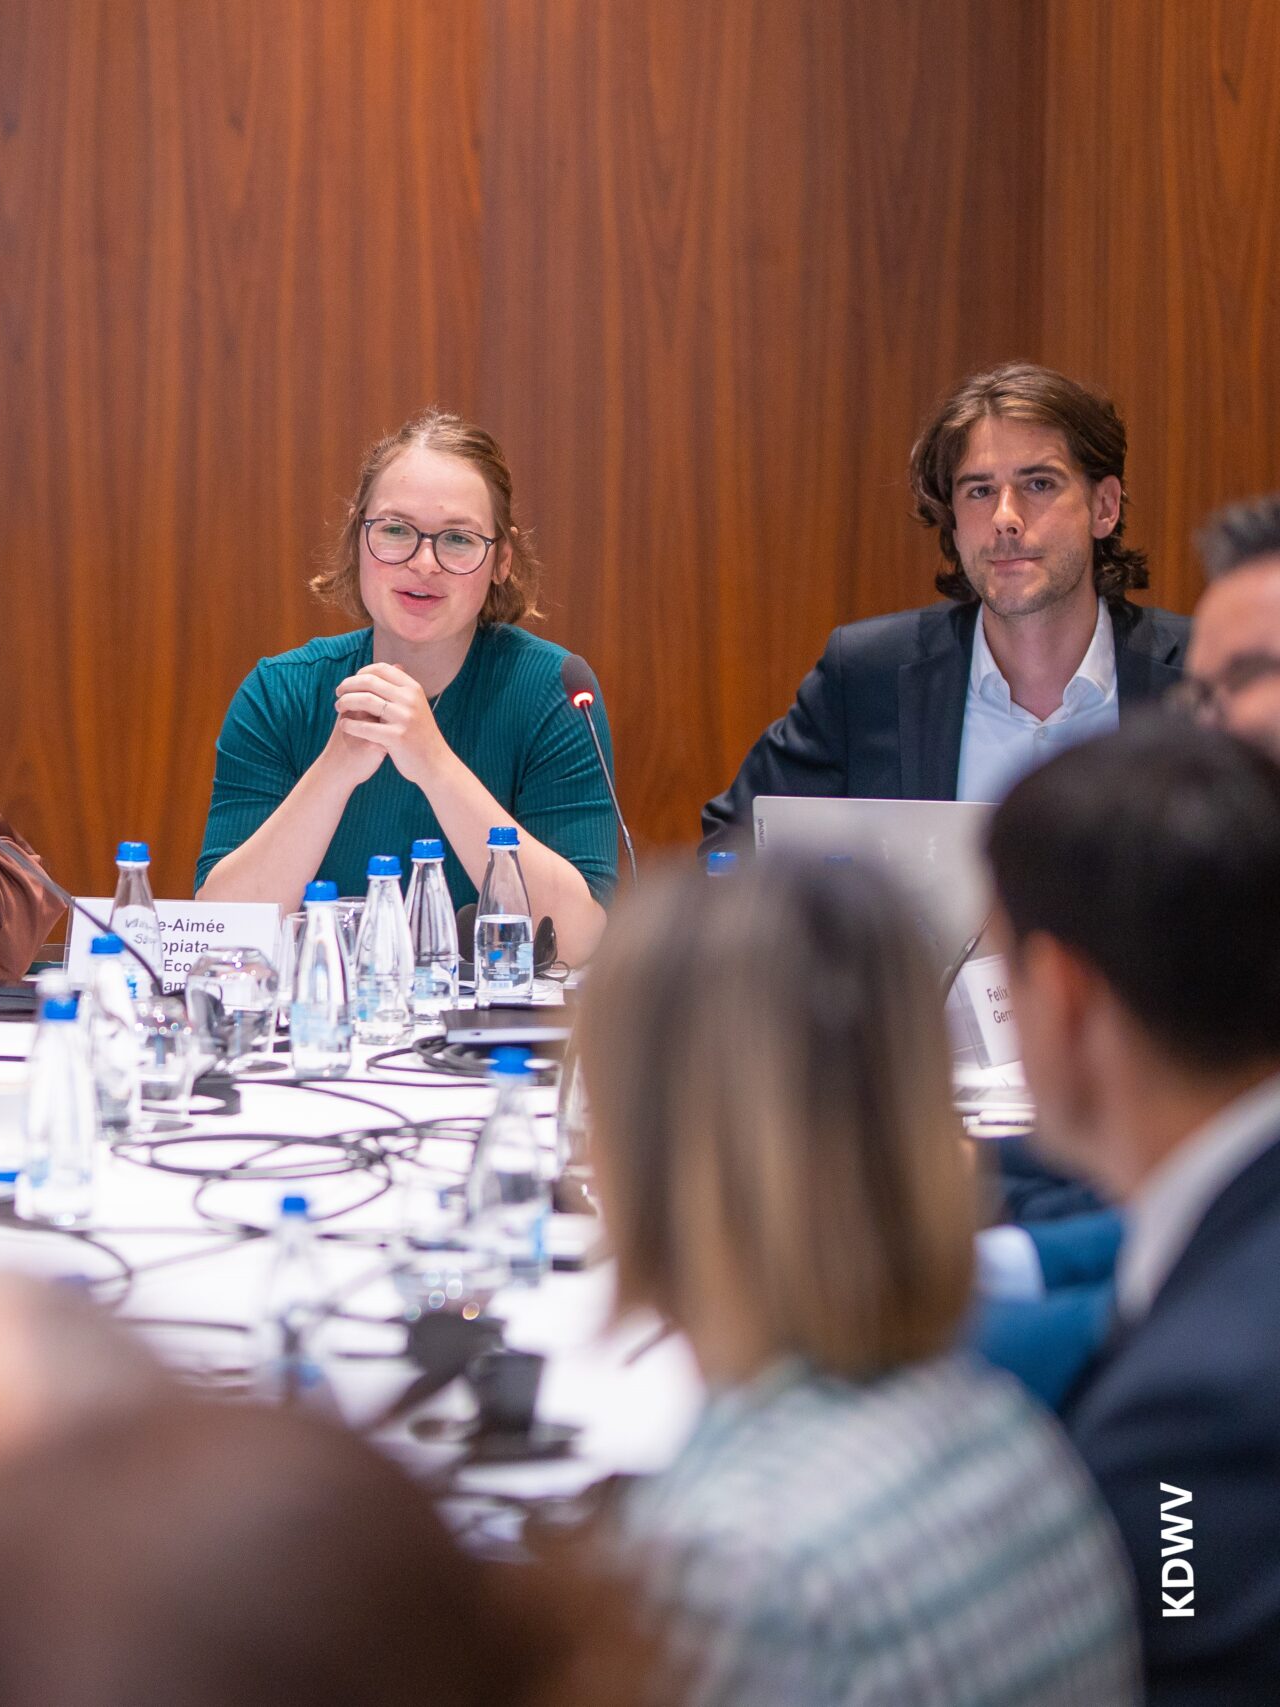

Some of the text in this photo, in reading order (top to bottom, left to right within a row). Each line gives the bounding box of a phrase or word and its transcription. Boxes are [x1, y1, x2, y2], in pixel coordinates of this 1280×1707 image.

[158, 918, 225, 933] e-Aimée
[162, 939, 209, 956] opiata
[164, 959, 192, 972] Eco
[987, 985, 1010, 1003] Felix
